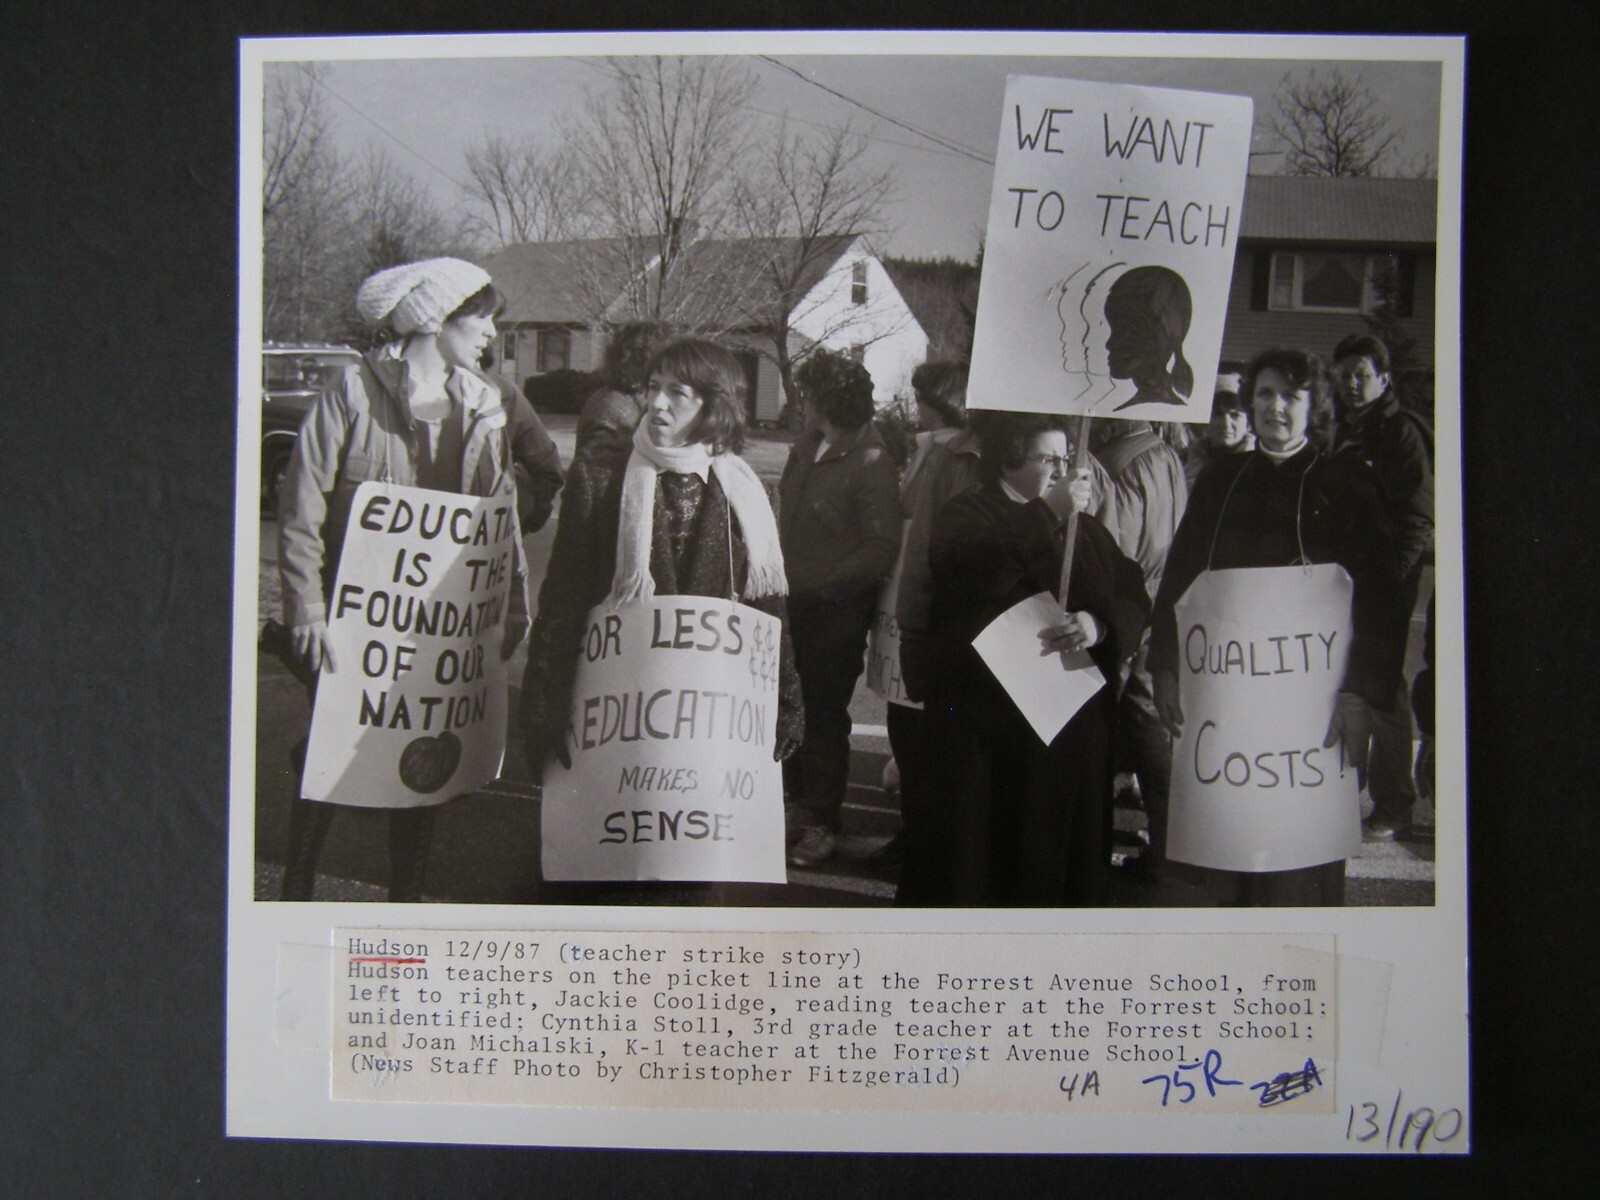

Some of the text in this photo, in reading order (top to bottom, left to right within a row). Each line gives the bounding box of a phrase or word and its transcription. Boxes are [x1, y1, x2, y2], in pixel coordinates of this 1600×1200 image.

[1015, 104, 1214, 168] WE WANT
[1008, 187, 1230, 248] TO TEACH
[392, 549, 508, 593] IS THE
[651, 608, 744, 656] LESS
[362, 640, 485, 686] OF OUR
[359, 688, 486, 731] NATION
[619, 767, 754, 801] MAKES NO
[599, 810, 736, 844] SENSE
[349, 938, 860, 969] Hudson 12/9/87 (teacher strike story)
[348, 962, 1316, 994] Hudson teachers on the picket line at the Forrest Avenue School, from
[350, 985, 400, 1002] left
[418, 989, 441, 1003] to
[460, 988, 537, 1014] right,
[556, 991, 637, 1008] Jackie
[654, 992, 775, 1015] Coolidge,
[796, 995, 892, 1017] reading
[910, 996, 1006, 1013] teacher
[1023, 1000, 1047, 1014] at
[1066, 997, 1104, 1014] the
[1122, 998, 1216, 1014] Forrest
[349, 1008, 522, 1032] unidentified;
[542, 1014, 637, 1034] Cynthia
[654, 1016, 733, 1038] Stoll,
[754, 1018, 792, 1034] 3rd
[809, 1019, 876, 1039] grade
[895, 1020, 991, 1037] teacher
[1008, 1023, 1032, 1037] at
[1051, 1021, 1089, 1038] the
[1107, 1022, 1201, 1038] Forrest
[348, 1032, 1199, 1062] and Joan Michalski, K-1 teacher at the Forrest Avenue School.
[352, 1053, 959, 1087] (News Staff Photo by Christopher Fitzgerald)
[1059, 1069, 1100, 1101] 4A
[1142, 1049, 1244, 1107] 75R
